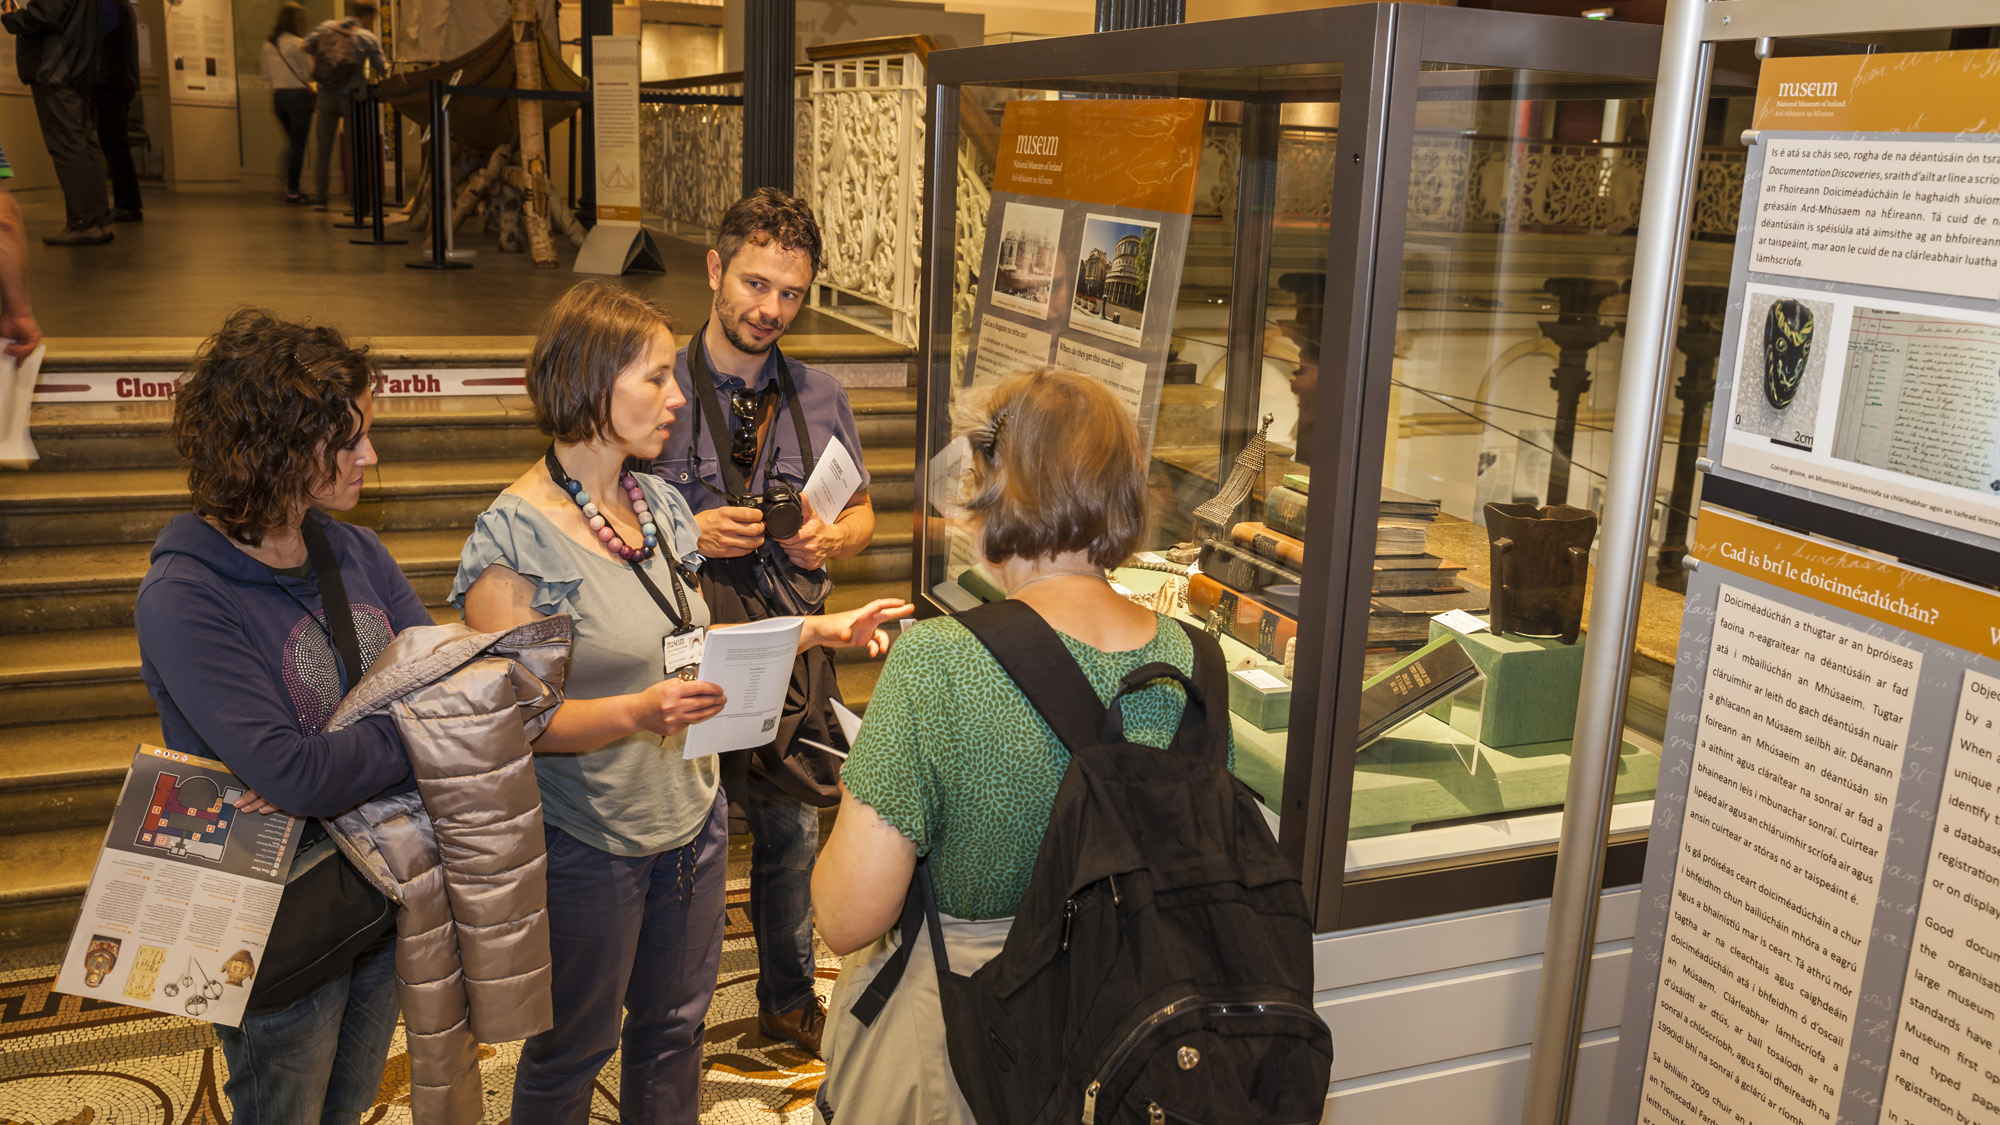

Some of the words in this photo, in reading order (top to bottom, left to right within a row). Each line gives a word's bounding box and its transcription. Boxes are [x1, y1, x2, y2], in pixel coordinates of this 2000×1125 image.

[1778, 82, 1838, 97] museum
[1016, 135, 1059, 155] museum
[1771, 148, 1779, 157] Is
[1779, 147, 1786, 158] é
[1786, 148, 1800, 158] atá
[1801, 150, 1811, 158] sa
[1812, 148, 1832, 159] chás
[1833, 151, 1851, 161] seo,
[1853, 150, 1880, 163] rogha
[1881, 150, 1894, 161] de
[1895, 153, 1907, 162] na
[1909, 151, 1964, 163] déantúsáin
[1966, 152, 1980, 164] ón
[1768, 165, 1831, 178] Documentation
[1831, 168, 1883, 181] Discoveries,
[1883, 170, 1911, 181] sraith
[1936, 174, 1948, 183] ar
[1947, 172, 1967, 184] líne
[1966, 175, 1974, 184] a
[1765, 185, 1777, 193] an
[1778, 183, 1820, 195] Fhoireann
[1822, 186, 1899, 200] Doiciméadúcháin
[1902, 190, 1912, 201] le
[1914, 190, 1961, 204] haghaidh
[1762, 201, 1797, 212] gréasáin
[1800, 203, 1861, 217] Ard-Mhúsaem
[1865, 209, 1877, 218] na
[1880, 206, 1926, 221] hÉireann.
[1931, 211, 1942, 223] Tá
[1946, 213, 1969, 224] cuid
[1973, 214, 1987, 226] de
[1760, 218, 1805, 231] déantúsáin
[1806, 221, 1814, 232] is
[1816, 223, 1854, 235] spéisiúla
[1855, 226, 1870, 237] atá
[1872, 227, 1913, 240] aimsithe
[1915, 232, 1928, 244] ag
[1929, 233, 1942, 242] an
[1755, 252, 1804, 267] lámhscríofa.
[1758, 237, 1768, 245] ar
[1768, 237, 1810, 251] taispeáint,
[1811, 242, 1829, 251] mar
[1829, 244, 1846, 253] aon
[1847, 243, 1856, 254] le
[1857, 245, 1877, 256] cuid
[1877, 246, 1890, 258] de
[1891, 250, 1903, 259] na
[1904, 249, 1964, 264] clárleabhair
[1964, 254, 1998, 268] luatha
[1060, 342, 1071, 354] Where
[1077, 348, 1085, 359] they
[371, 374, 441, 394] Tarbh
[1735, 414, 1741, 425] 0
[1794, 431, 1814, 445] 2cm
[1720, 542, 1746, 564] Cad
[1748, 551, 1760, 567] is
[1762, 554, 1784, 575] brí
[1785, 561, 1798, 580] le
[1800, 568, 1940, 625] doiciméadúchán?
[1724, 593, 1792, 626] Doiciméadúchán
[1794, 620, 1800, 629] a
[1802, 622, 1836, 641] thugtar
[1838, 636, 1849, 646] ar
[1851, 640, 1864, 652] an
[1866, 643, 1914, 670] bpróiseas
[1720, 617, 1745, 635] faoina
[1748, 630, 1801, 656] n-eagraítear
[1804, 651, 1816, 662] na
[1820, 656, 1872, 684] déantúsáin
[1876, 678, 1888, 689] ar
[1892, 682, 1909, 697] fad
[1716, 644, 1729, 655] atá
[1733, 648, 1738, 659] i
[1741, 654, 1792, 681] mbailiúchán
[1797, 676, 1809, 687] an
[1814, 681, 1865, 710] Mhúsaeim.
[1872, 703, 1904, 724] Tugtar
[1712, 667, 1753, 691] cláruimhir
[1753, 685, 1764, 695] ar
[1764, 687, 1784, 705] leith
[1785, 697, 1798, 710] do
[1798, 704, 1820, 720] gach
[1821, 712, 1871, 741] déantúsán
[1872, 735, 1899, 752] nuair
[1965, 709, 1979, 726] by
[1985, 720, 1992, 729] a
[1960, 737, 1993, 760] When
[1954, 768, 1993, 791] unique
[1948, 793, 1991, 823] identify
[1942, 824, 1950, 834] a
[1937, 851, 2000, 887] registration
[1932, 879, 1945, 890] or
[1946, 885, 1961, 899] on
[1924, 916, 1955, 939] Good
[1919, 943, 1938, 960] the
[1914, 968, 1941, 991] large
[1947, 988, 1995, 1021] museum
[1908, 997, 1961, 1032] standards
[1965, 1026, 1993, 1050] have
[1904, 1020, 1951, 1056] Museum
[1956, 1051, 1979, 1073] first
[1899, 1048, 1920, 1066] and
[1930, 1065, 1962, 1091] typed
[1894, 1074, 1954, 1117] registration
